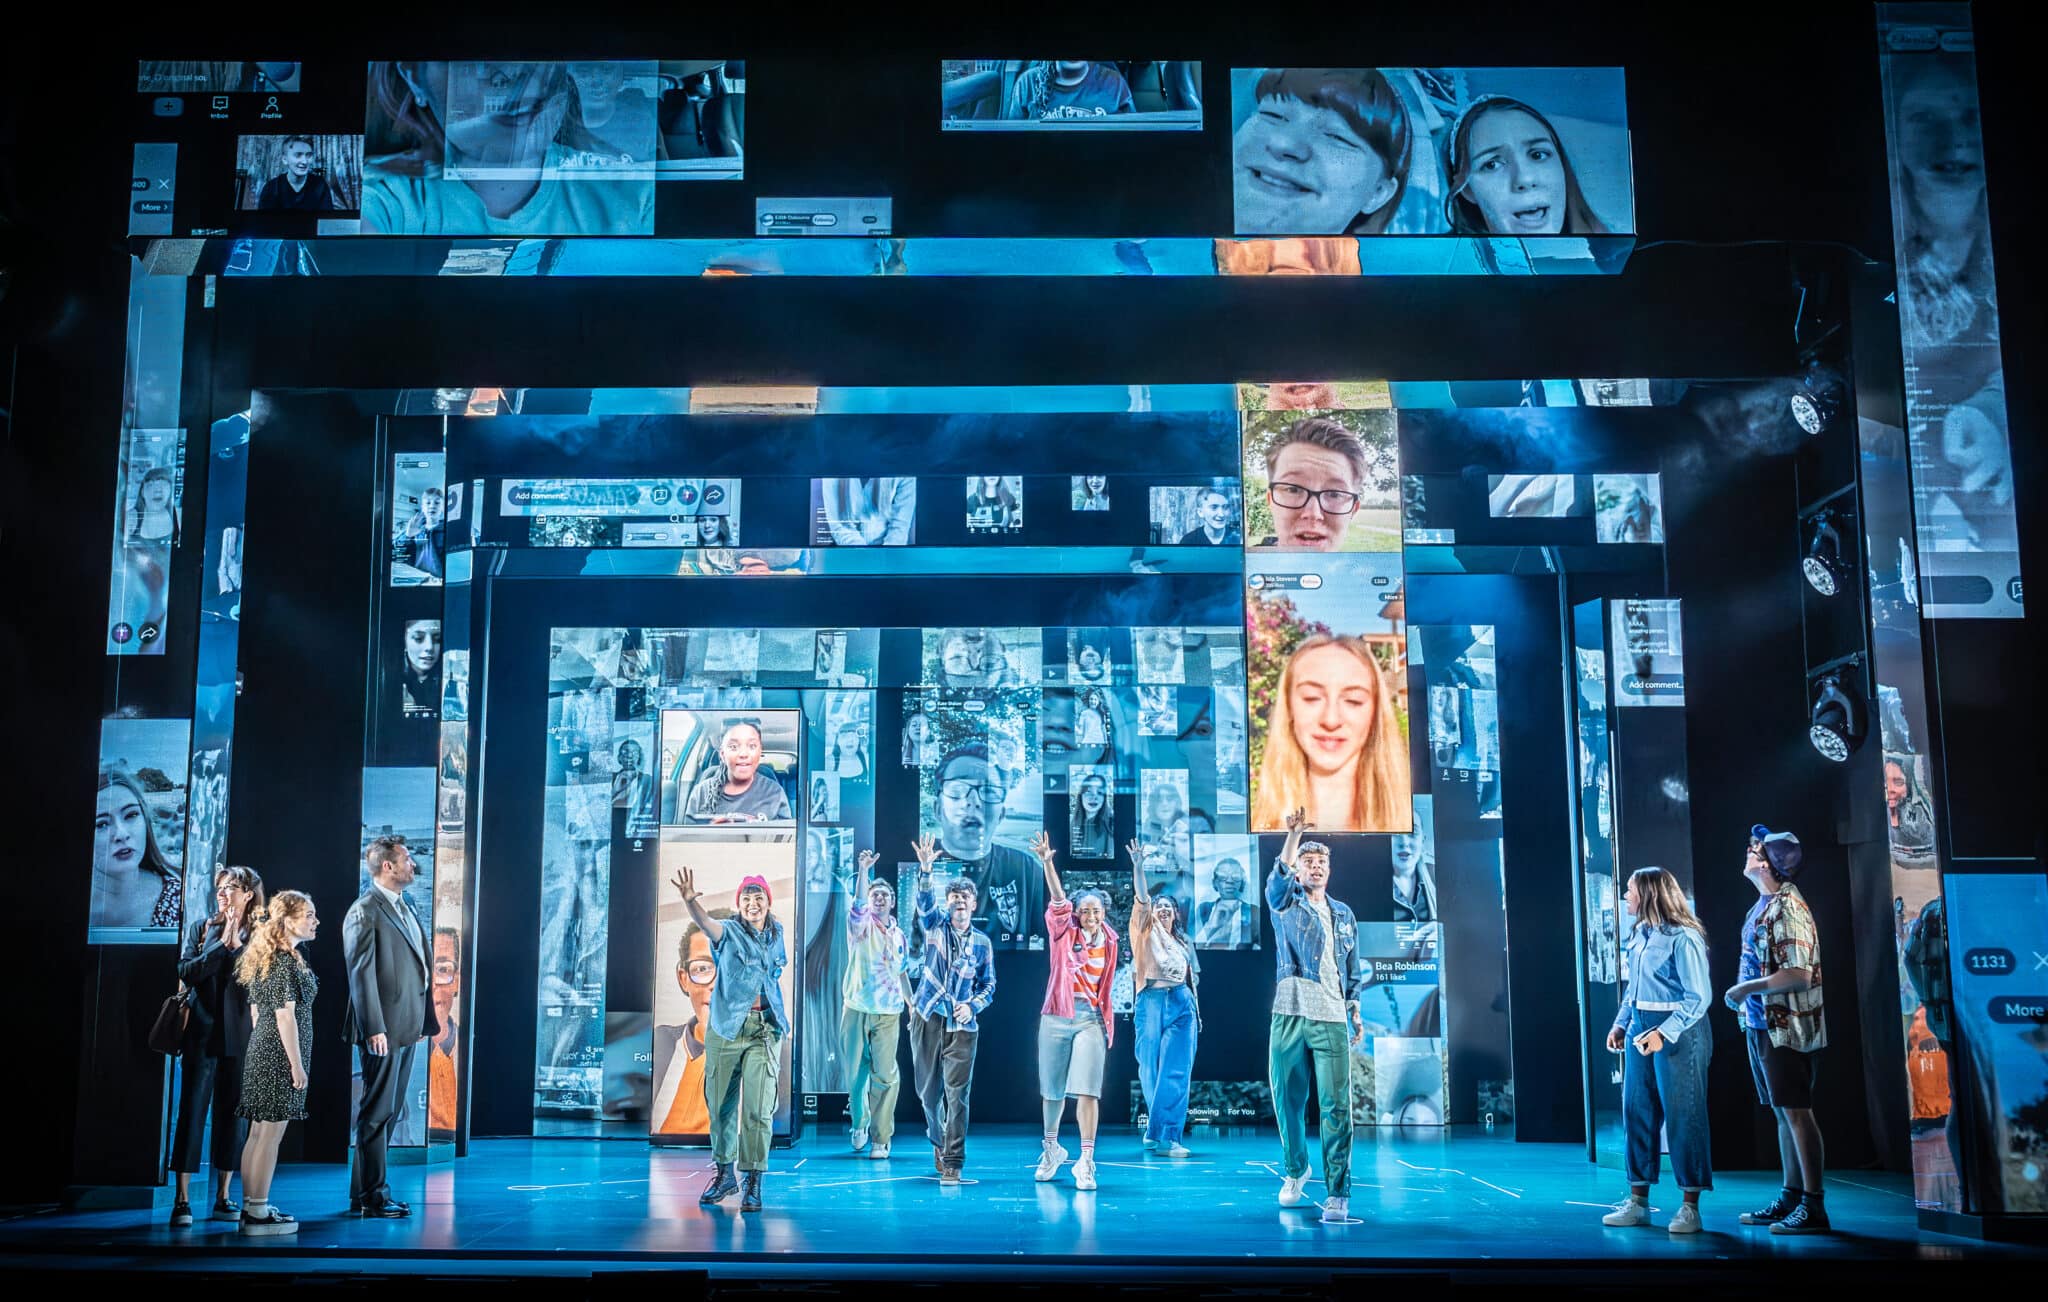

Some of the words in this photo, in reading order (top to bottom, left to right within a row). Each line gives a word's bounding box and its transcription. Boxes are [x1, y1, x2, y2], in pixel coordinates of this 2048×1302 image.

[141, 204, 161, 212] More
[515, 491, 530, 500] Add
[1628, 680, 1644, 690] Add
[1375, 961, 1393, 971] Bea
[1394, 961, 1437, 971] Robinson
[1971, 955, 2008, 968] 1131
[1375, 973, 1389, 981] 161
[1390, 972, 1407, 981] likes
[2005, 1003, 2045, 1017] More
[1227, 1108, 1240, 1116] For
[1241, 1108, 1256, 1116] You
